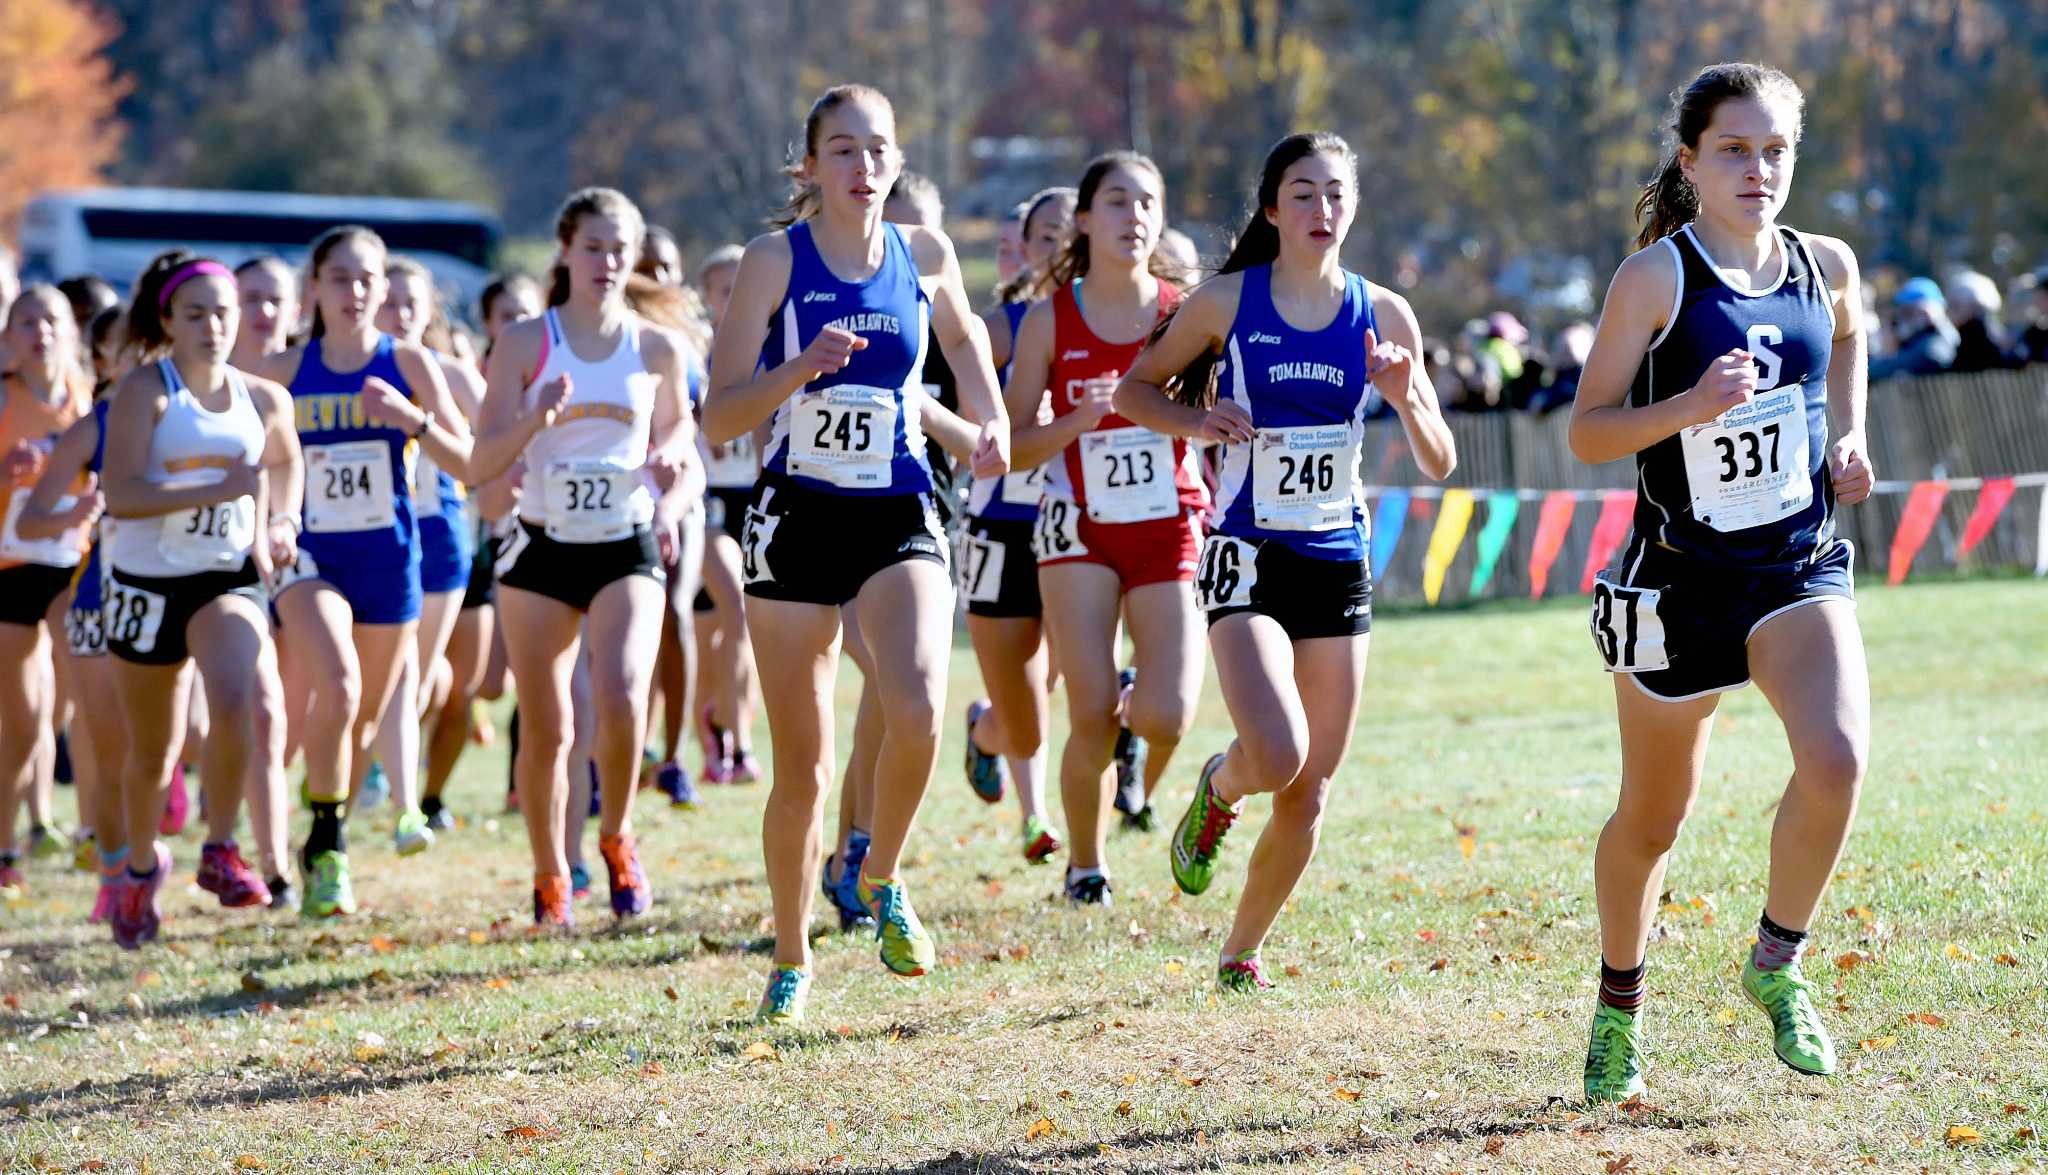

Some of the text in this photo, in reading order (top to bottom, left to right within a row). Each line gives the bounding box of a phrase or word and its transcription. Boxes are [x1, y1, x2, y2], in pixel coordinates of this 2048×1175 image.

[823, 313, 900, 334] OMAHAWKS
[1268, 362, 1344, 387] TOMAHAWKS
[1746, 324, 1783, 391] S
[294, 391, 403, 432] NEWTO
[1723, 403, 1796, 429] Championships
[1755, 394, 1791, 412] Country
[814, 409, 872, 452] 245
[1104, 450, 1155, 488] 213
[1713, 423, 1780, 483] 337
[325, 465, 371, 499] 284
[1278, 453, 1334, 495] 246
[565, 478, 611, 511] 322
[185, 506, 231, 538] 318
[1591, 582, 1642, 667] 37
